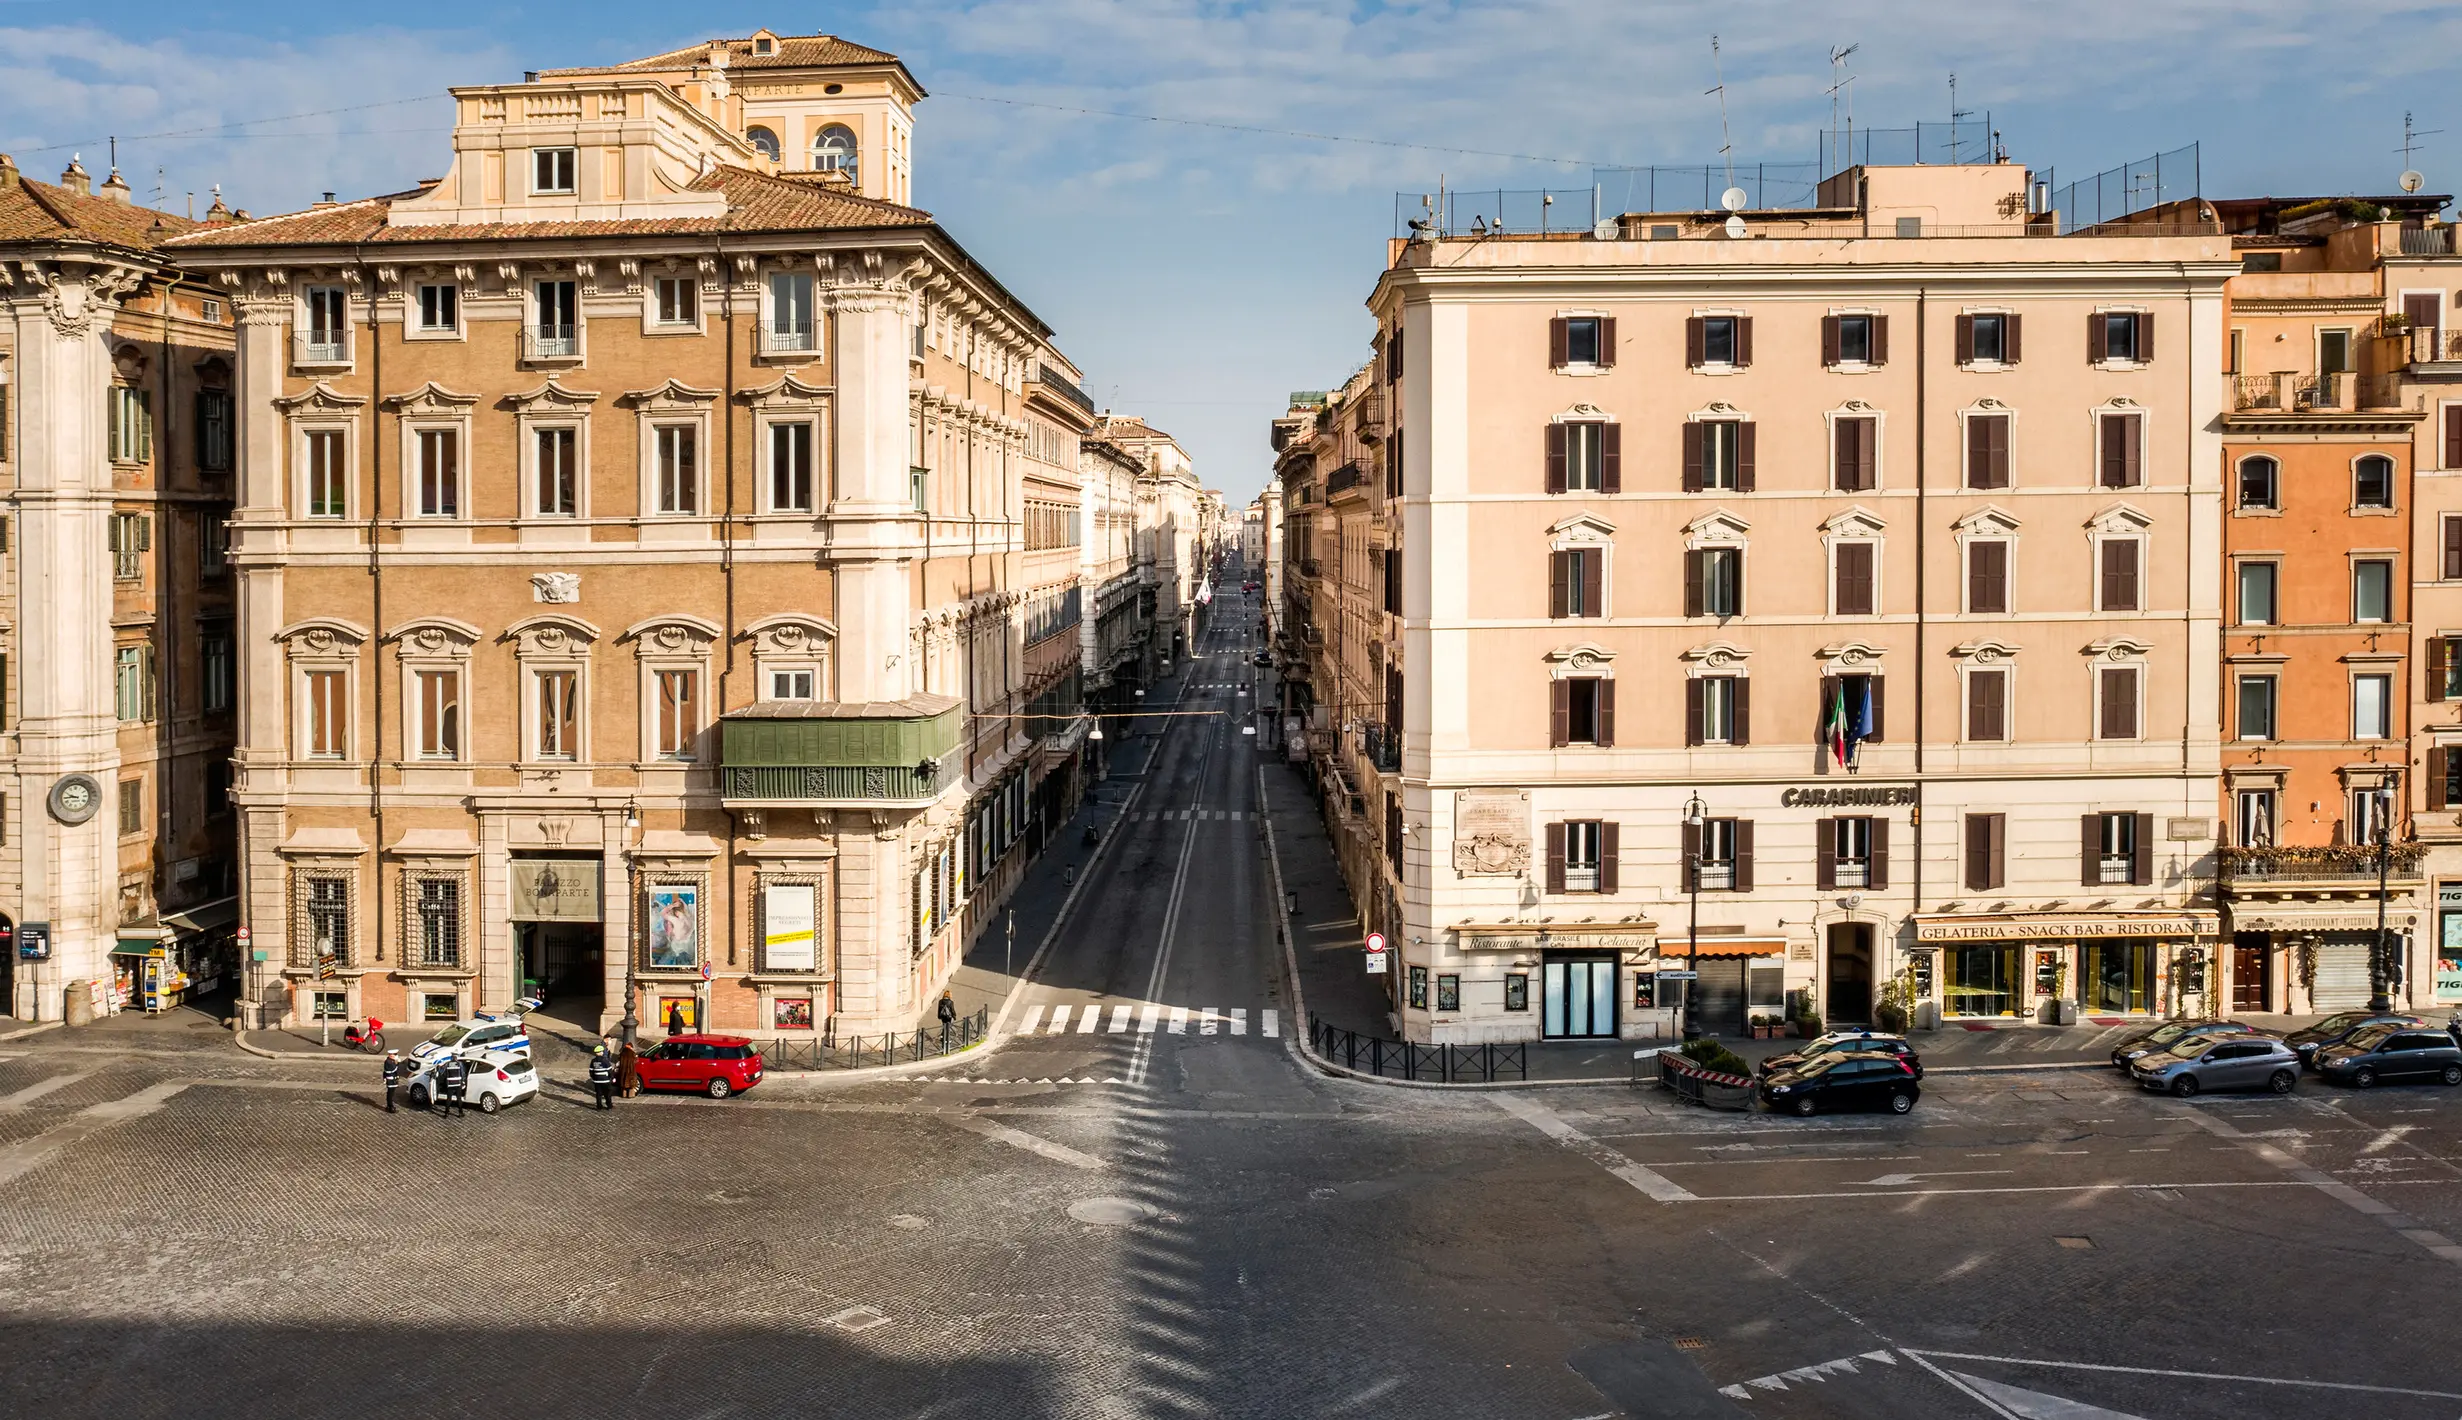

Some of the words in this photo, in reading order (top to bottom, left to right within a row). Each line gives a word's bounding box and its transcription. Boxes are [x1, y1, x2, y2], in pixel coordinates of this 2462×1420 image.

[733, 84, 804, 96] NAPARTE
[1781, 787, 1918, 807] CARABINIERI
[534, 878, 581, 887] PALAZZO
[526, 888, 590, 897] BONAPARTE
[1922, 927, 2006, 939] GELATERIA
[2018, 925, 2070, 937] SNACK
[2074, 924, 2105, 935] BAR
[2117, 922, 2215, 935] RISTORANTE
[1469, 937, 1523, 949] Ristorante
[1534, 935, 1549, 943] BAR
[1598, 935, 1646, 947] Gelateria
[2437, 980, 2462, 989] TIG
[680, 1004, 694, 1012] EGO
